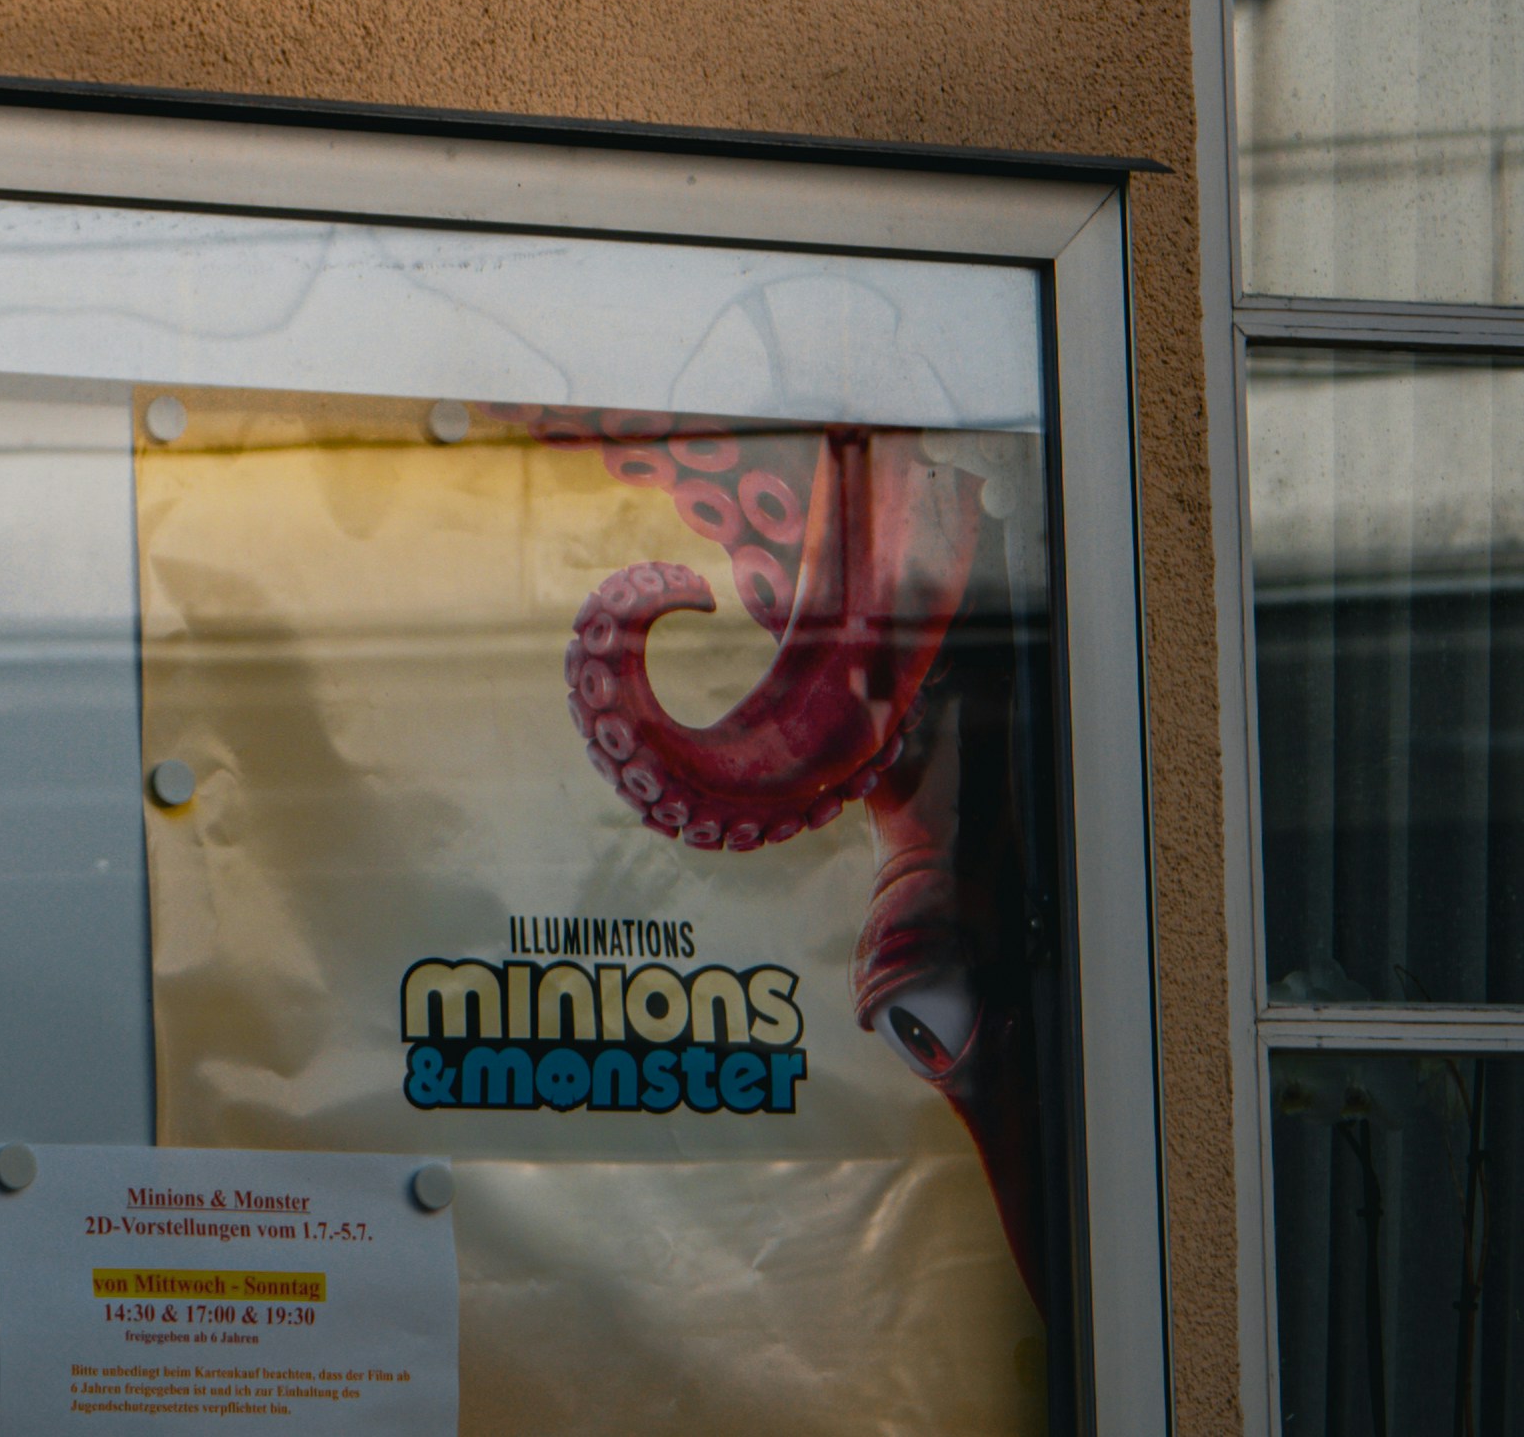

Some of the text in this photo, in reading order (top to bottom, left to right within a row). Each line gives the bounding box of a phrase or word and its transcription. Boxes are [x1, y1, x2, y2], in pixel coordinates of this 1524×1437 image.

[509, 916, 696, 958] ILLUMINATIONS
[127, 1188, 310, 1211] Minions & Monster
[84, 1216, 251, 1242] 2D-Vorstellungen
[257, 1225, 296, 1239] vom
[94, 1278, 128, 1293] von
[134, 1274, 225, 1295] Mittwoch
[244, 1276, 320, 1300] Sonntag
[103, 1303, 315, 1326] 14:30 & 17:00 & 19:30
[125, 1330, 190, 1346] freigegeben
[195, 1331, 207, 1343] ab
[222, 1332, 259, 1344] Jahren
[71, 1364, 99, 1377] Bitte
[102, 1365, 160, 1381] unbedingt
[163, 1366, 191, 1379] beim
[195, 1366, 260, 1380] Kartenkauf
[319, 1369, 342, 1381] dass
[346, 1369, 364, 1381] der
[367, 1369, 393, 1382] Film
[397, 1370, 411, 1382] ab
[80, 1383, 121, 1396] Jahren
[125, 1383, 190, 1399] freigegeben
[193, 1384, 207, 1396] ist
[210, 1384, 231, 1397] und
[235, 1385, 251, 1397] ich
[255, 1388, 273, 1398] zur
[277, 1385, 339, 1402] Einhaltung
[342, 1386, 361, 1399] des
[202, 1401, 267, 1417] verpflichtet
